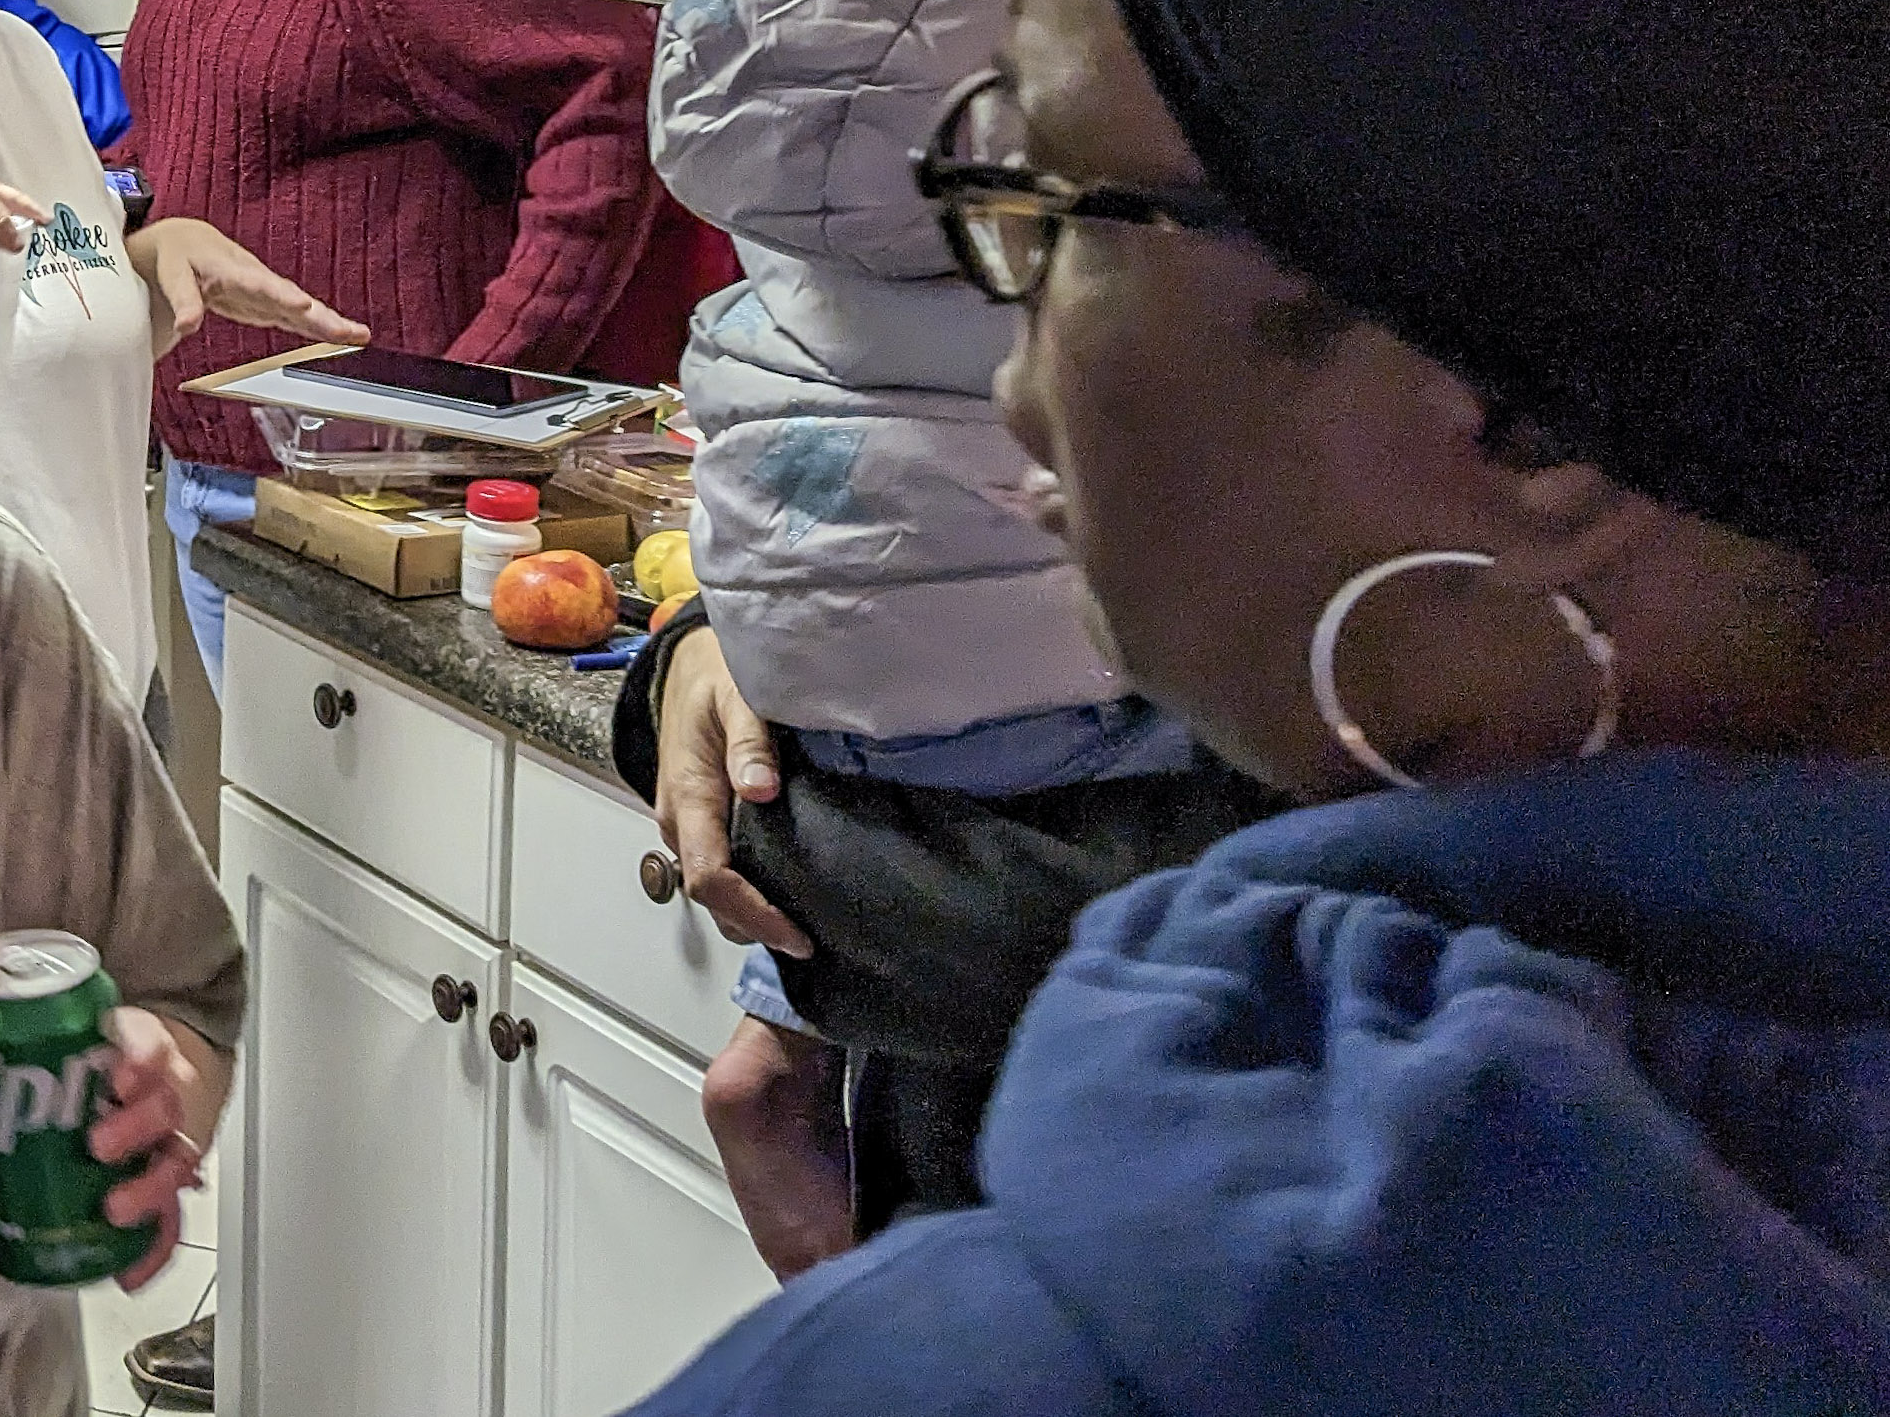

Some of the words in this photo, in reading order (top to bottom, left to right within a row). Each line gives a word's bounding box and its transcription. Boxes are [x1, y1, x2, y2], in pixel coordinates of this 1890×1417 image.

[27, 210, 108, 260] erokee
[22, 262, 69, 281] CERNED
[73, 255, 116, 271] CITIZENS
